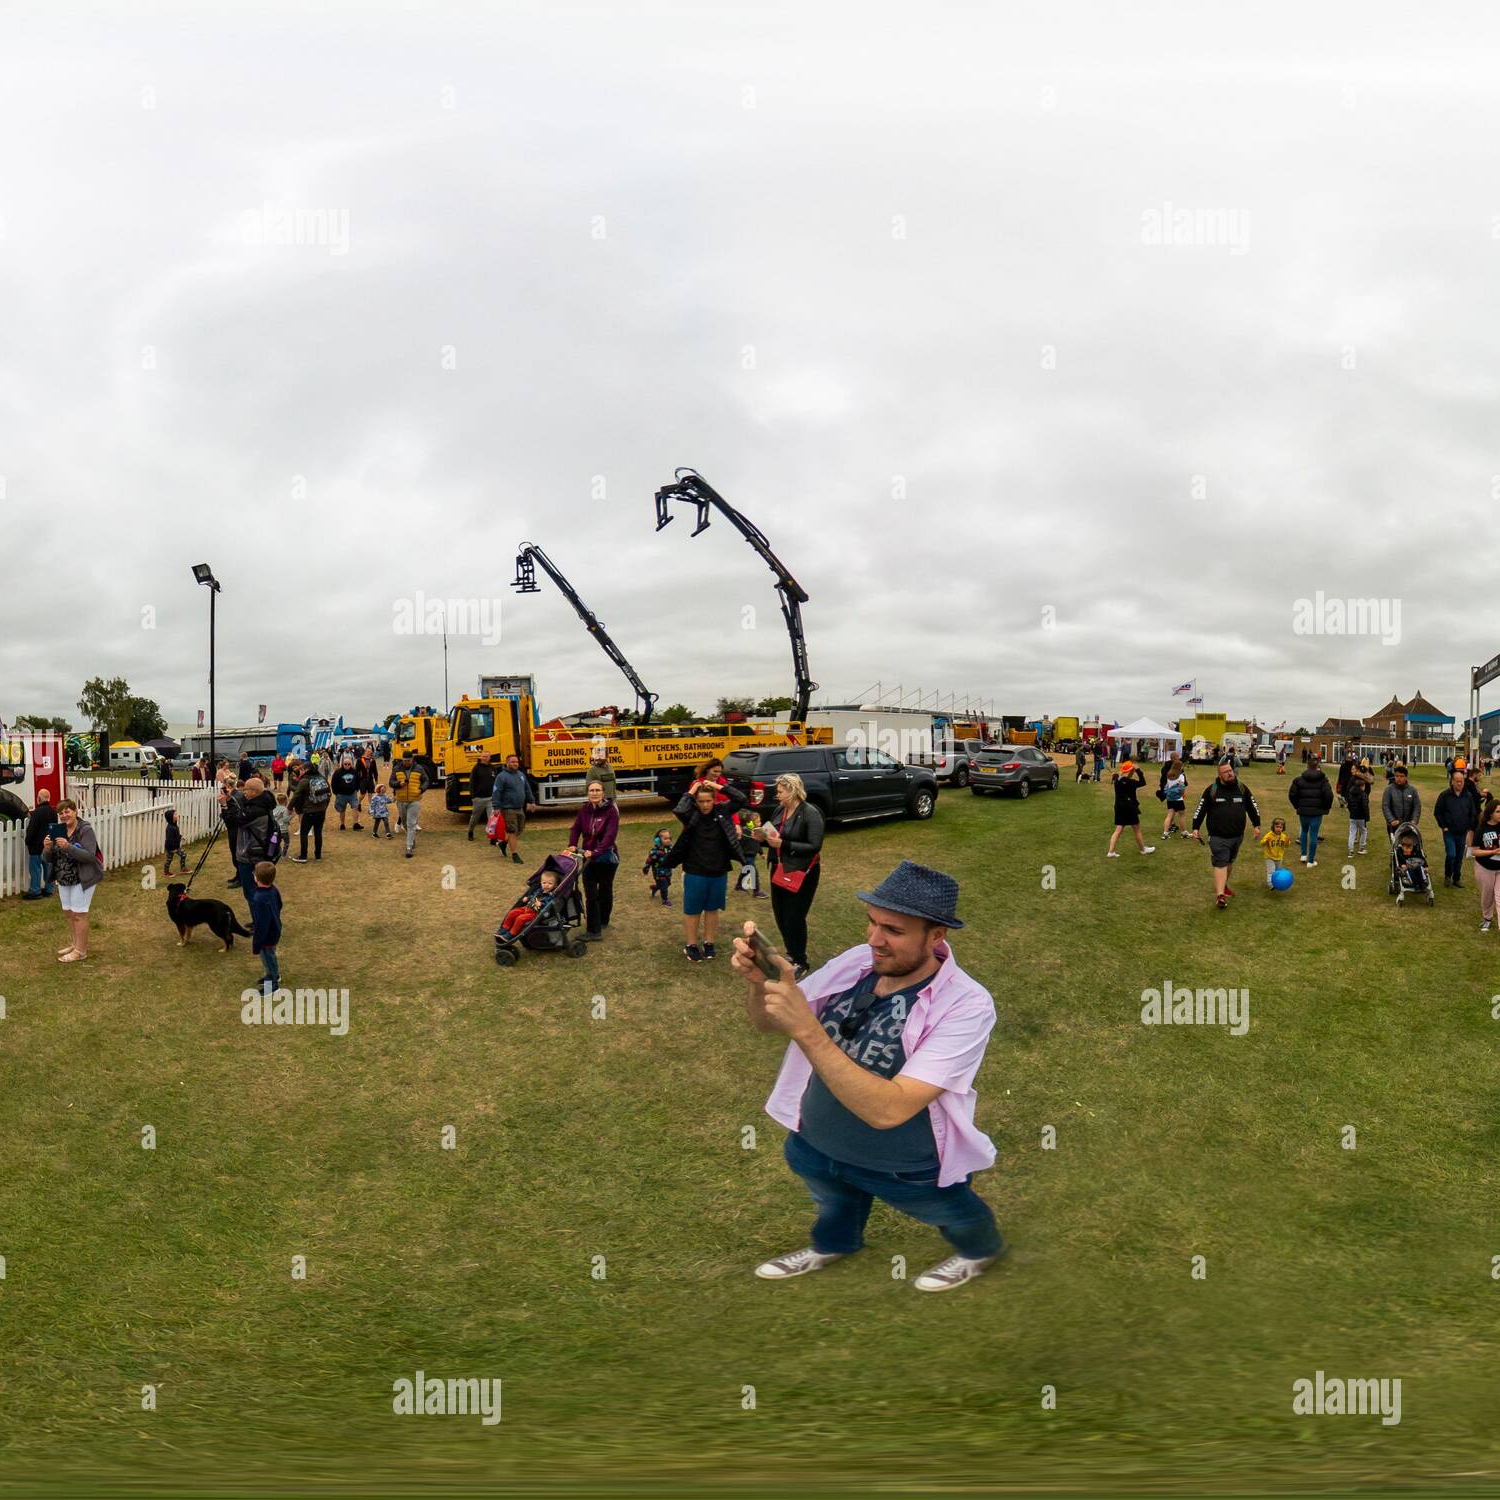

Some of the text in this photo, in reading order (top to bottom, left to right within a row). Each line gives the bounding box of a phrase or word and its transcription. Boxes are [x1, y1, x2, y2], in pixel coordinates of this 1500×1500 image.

[463, 744, 484, 752] MKM
[547, 747, 587, 757] BUILDING,
[643, 742, 725, 753] KITCHENS, BATHROOMS
[657, 751, 713, 761] & LANDSCAPING
[544, 757, 587, 767] PLUMBING,
